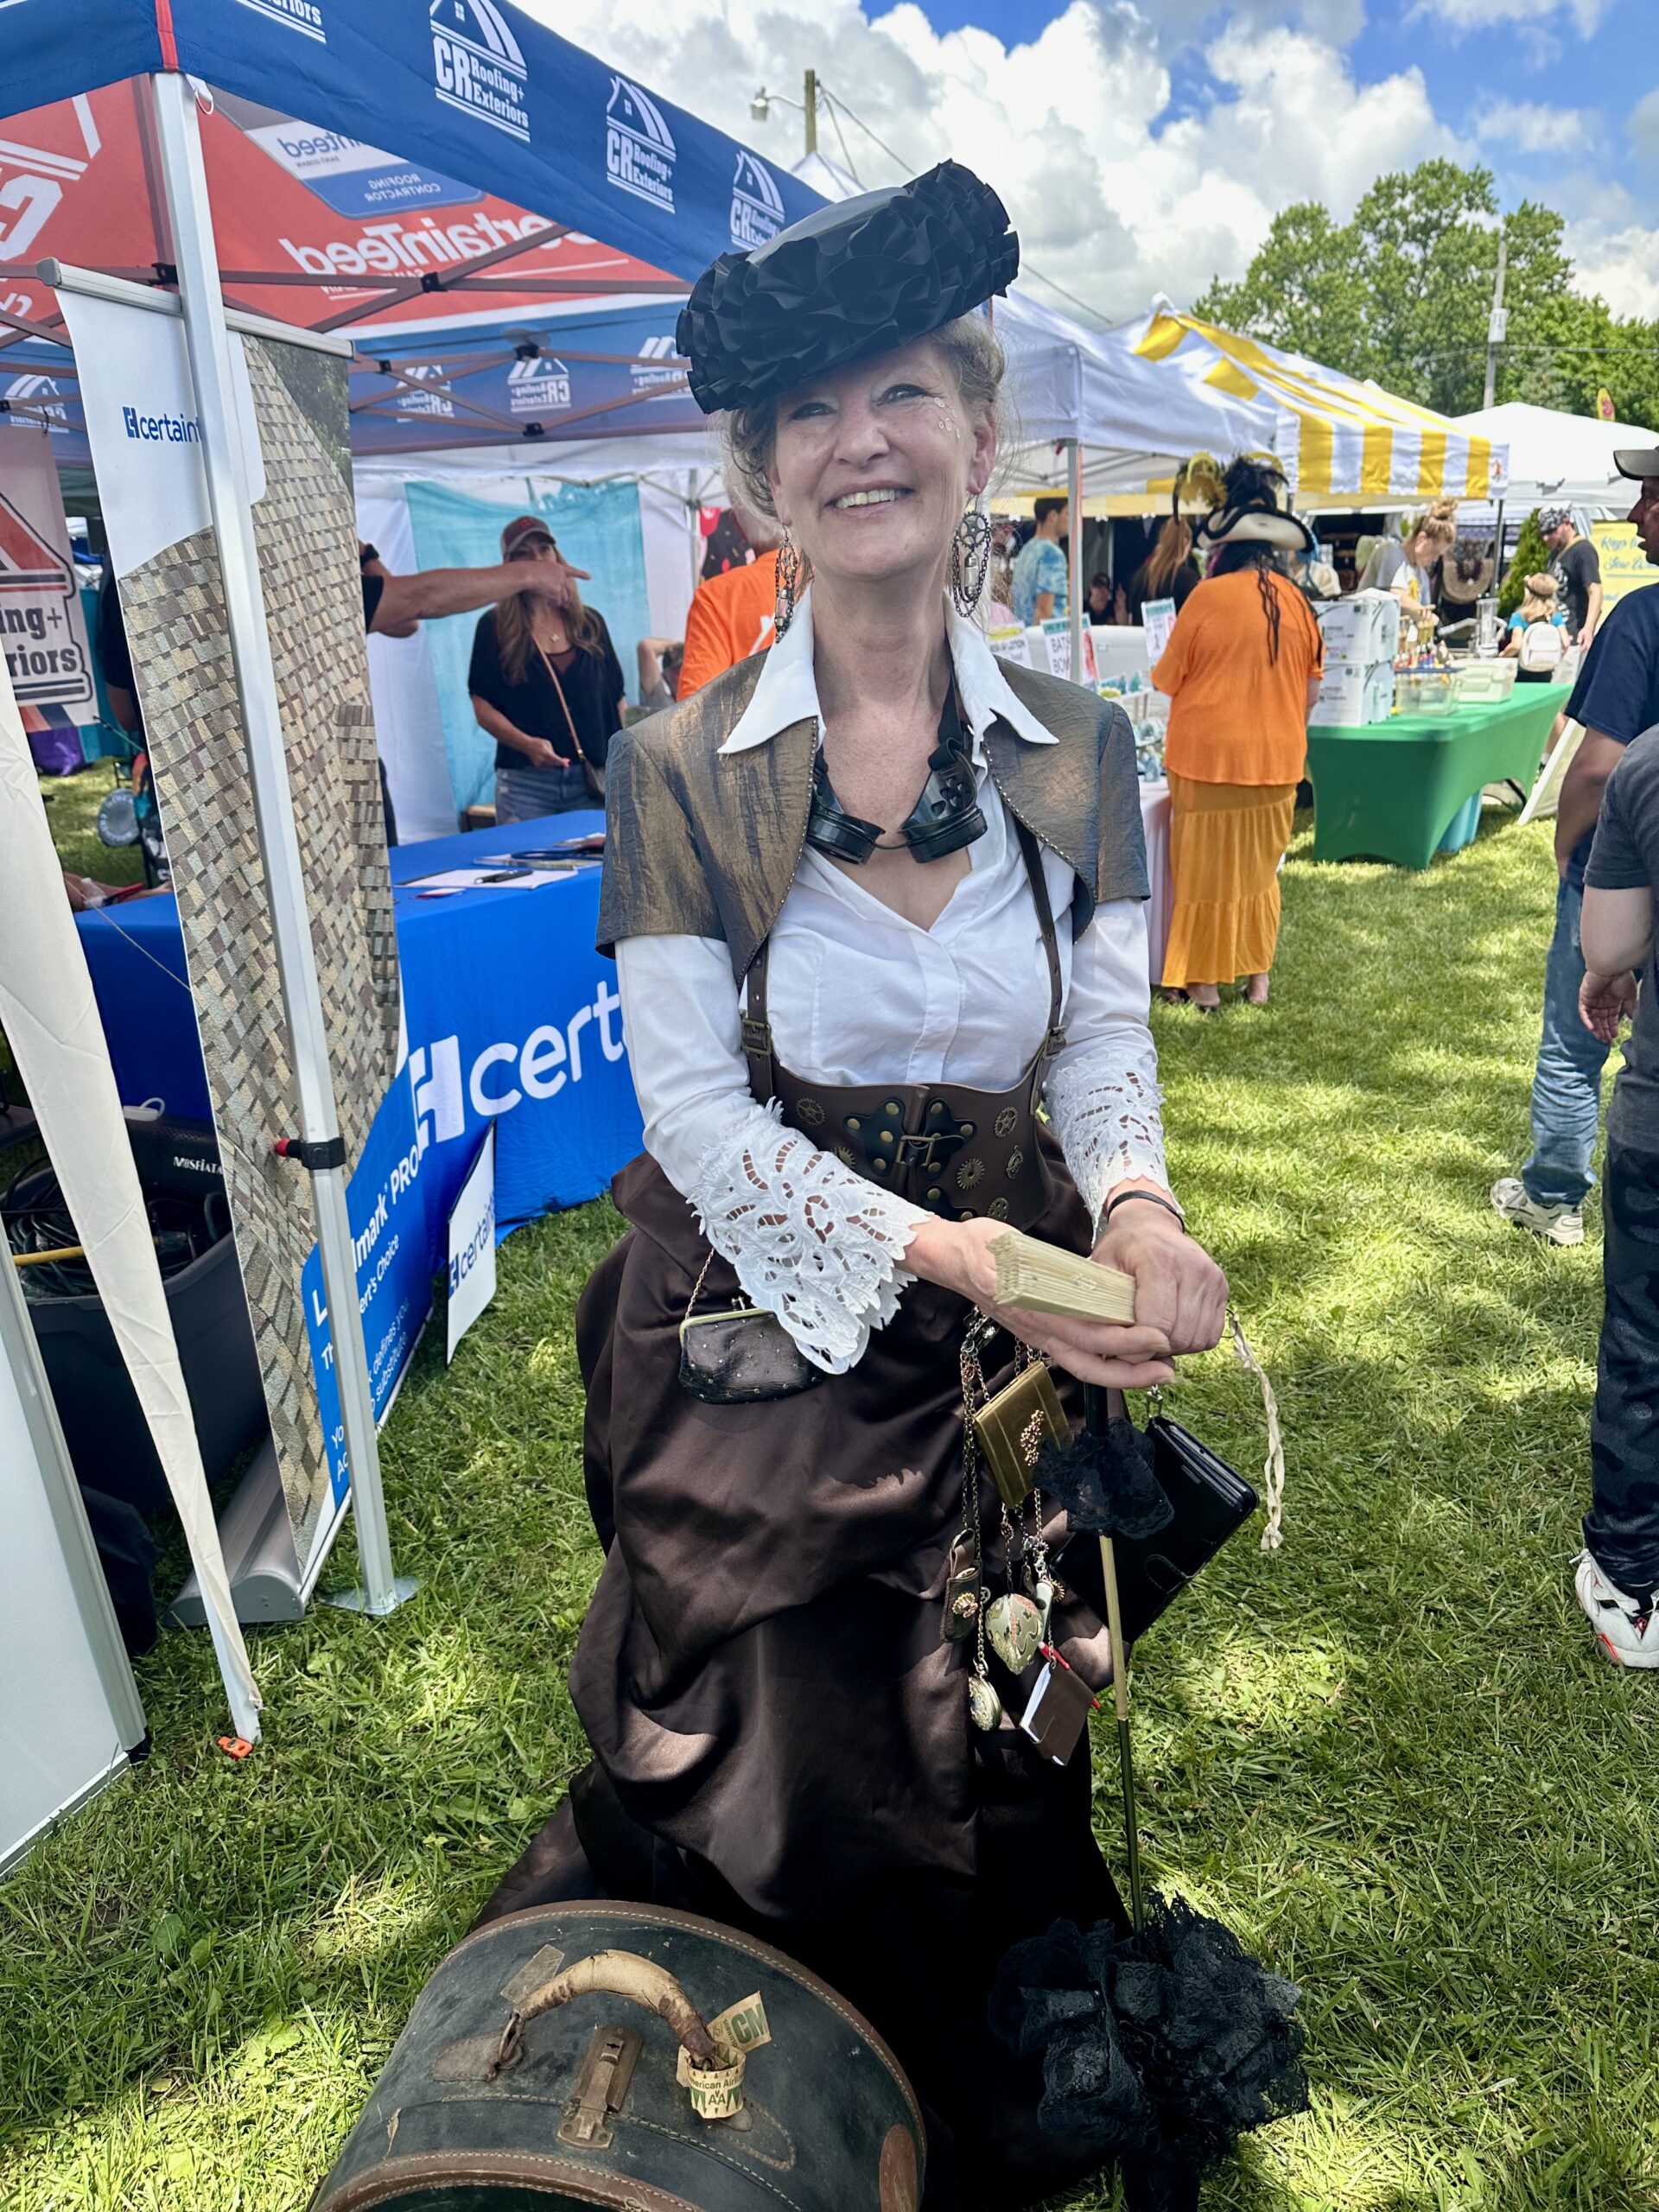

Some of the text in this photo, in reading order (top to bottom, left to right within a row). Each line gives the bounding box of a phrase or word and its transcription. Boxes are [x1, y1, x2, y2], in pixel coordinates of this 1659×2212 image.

[433, 35, 474, 102] CR
[472, 80, 529, 129] Exteriors
[607, 128, 634, 183] CR
[730, 197, 752, 243] CR
[390, 1144, 420, 1206] PRO
[376, 1234, 400, 1281] Choice
